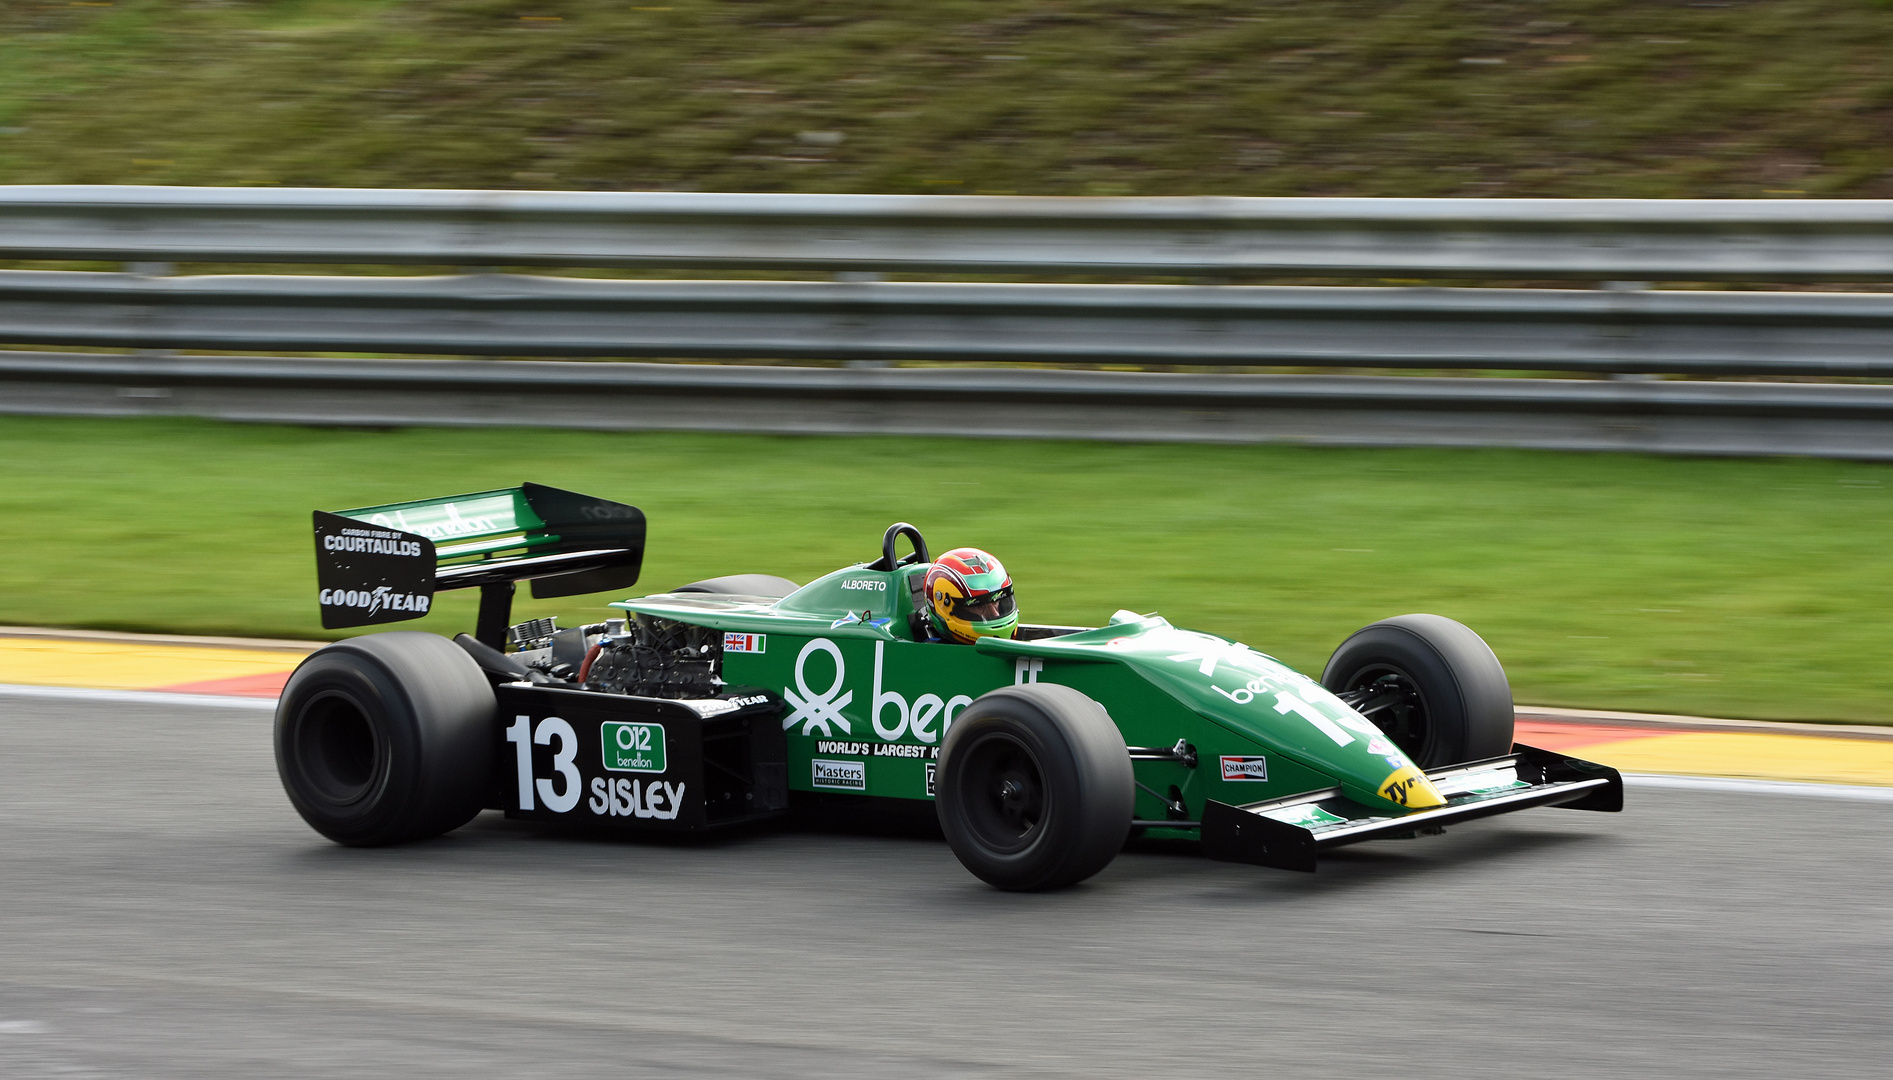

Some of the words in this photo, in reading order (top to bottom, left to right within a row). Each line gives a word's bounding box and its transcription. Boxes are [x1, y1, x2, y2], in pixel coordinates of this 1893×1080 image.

[341, 527, 370, 538] CARBON
[371, 530, 392, 539] FIBRE
[392, 531, 403, 540] BY
[324, 535, 421, 557] COURTAULDS
[841, 579, 887, 592] ALBORETO
[818, 741, 870, 756] WORLD'S
[873, 743, 927, 759] LARGEST
[506, 715, 582, 813] 13
[616, 750, 653, 769] benetton
[815, 763, 862, 779] Masters
[1224, 763, 1264, 775] CHAMPION
[842, 779, 863, 787] RACING
[589, 777, 686, 820] SISLEY
